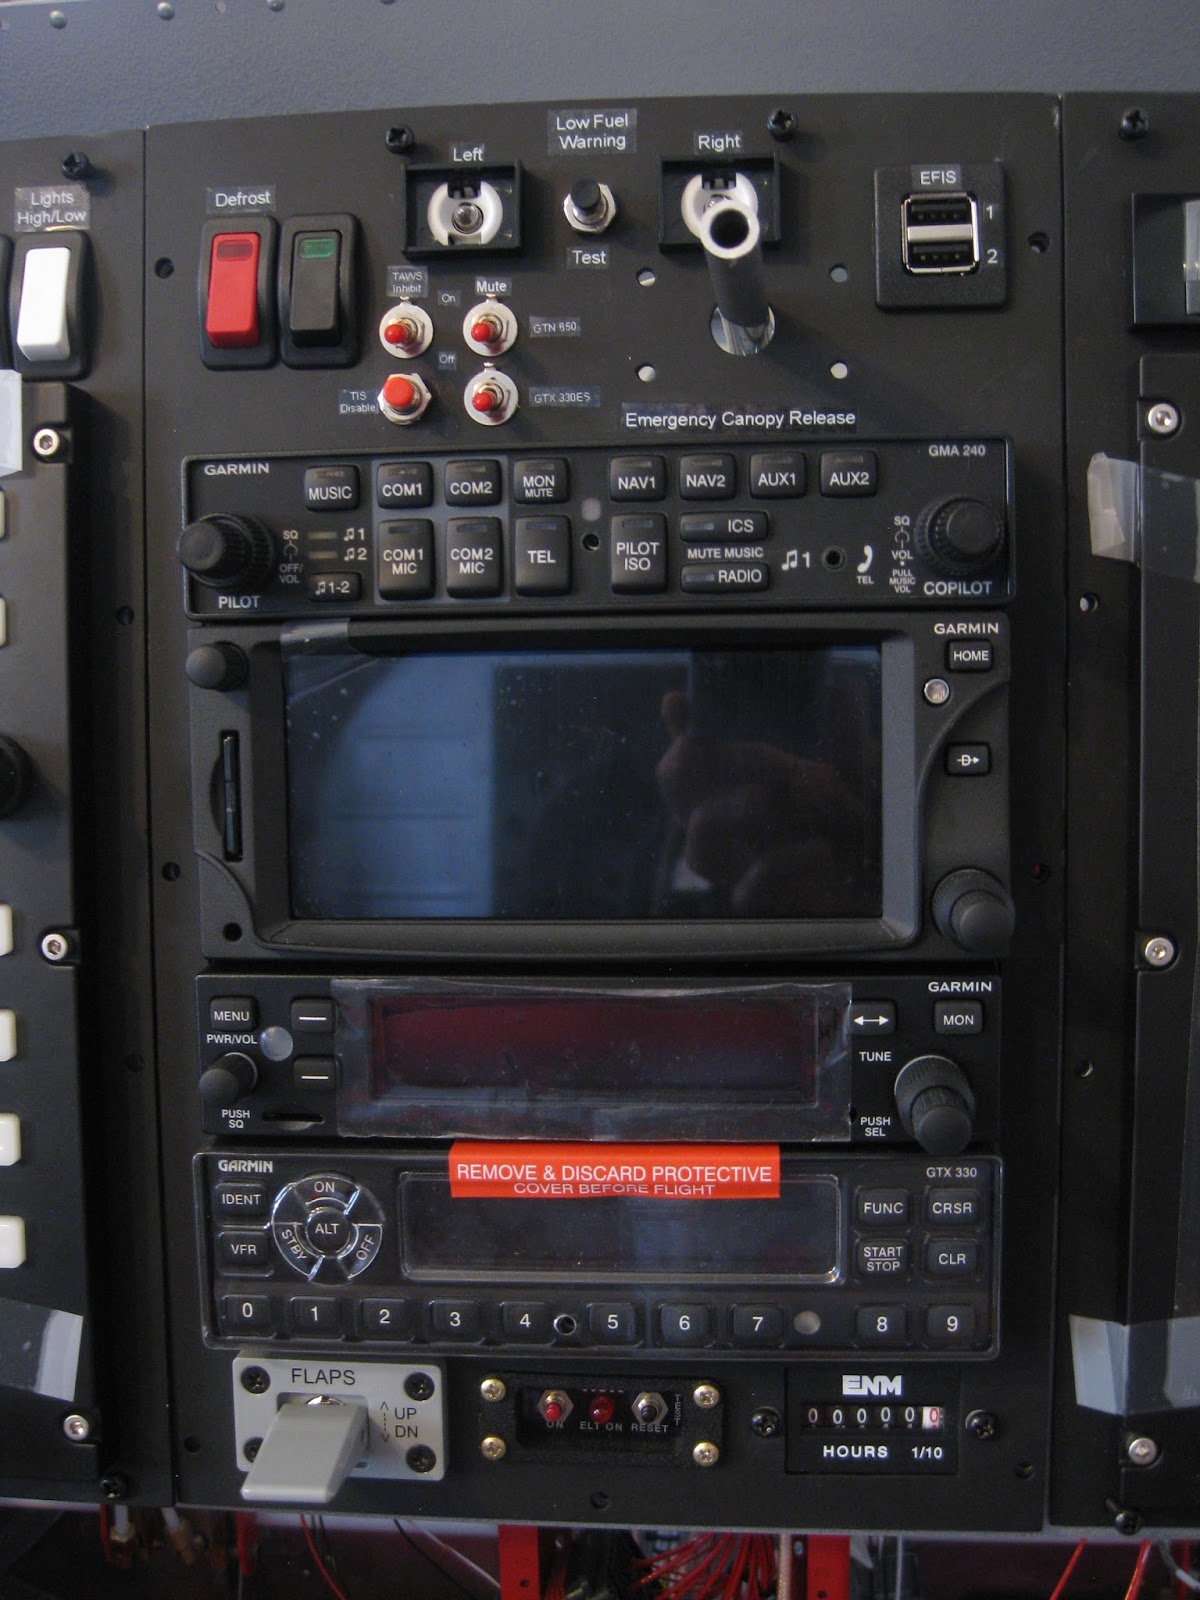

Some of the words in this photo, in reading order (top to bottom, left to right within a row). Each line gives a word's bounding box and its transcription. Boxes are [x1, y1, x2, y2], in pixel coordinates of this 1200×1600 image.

[556, 117, 590, 130] Low
[594, 114, 628, 129] Fuel
[559, 134, 626, 150] Warning
[698, 135, 741, 152] Right
[453, 148, 484, 162] Left
[920, 171, 956, 186] EFIS
[31, 191, 74, 207] Lights
[215, 192, 272, 208] Defrost
[17, 210, 86, 226] High/Low
[986, 206, 993, 219] 1
[572, 250, 606, 264] Test
[987, 250, 998, 264] 2
[392, 272, 423, 281] TAWS
[393, 284, 422, 293] Inhibit
[476, 280, 507, 293] Mute
[442, 294, 456, 302] On
[533, 323, 556, 334] GTN
[559, 322, 577, 332] 650
[440, 354, 456, 364] Off
[350, 391, 367, 400] TIS
[534, 393, 556, 403] GTX
[558, 392, 590, 402] 330ES
[340, 403, 376, 414] Disable
[626, 412, 716, 429] Emergency
[721, 411, 785, 428] Canopy
[790, 410, 856, 426] Release
[928, 445, 960, 457] GMA
[962, 444, 986, 456] 240
[204, 462, 270, 476] GARMIN
[522, 475, 556, 488] MON
[618, 476, 656, 490] NAV1
[686, 474, 726, 488] NAV2
[758, 472, 796, 486] AUX1
[830, 472, 870, 486] AUX2
[308, 486, 352, 500] MUSIC
[382, 483, 423, 497] COM1
[450, 481, 493, 494] COM2
[524, 488, 554, 498] MUTE
[728, 519, 754, 533] ICS
[894, 516, 910, 526] SQ
[283, 530, 299, 540] SQ
[358, 528, 365, 540] 1
[357, 548, 368, 560] 2
[450, 548, 494, 560] COM2
[616, 542, 660, 556] PILOT
[688, 548, 721, 560] MUTE
[724, 546, 764, 558] MUSIC
[891, 550, 914, 560] VOL
[528, 550, 556, 564] TEL
[802, 551, 810, 568] 1
[392, 562, 418, 574] MIC
[459, 562, 485, 574] MIC
[624, 558, 651, 571] ISO
[279, 574, 300, 584] VOL
[718, 569, 762, 584] RADIO
[856, 575, 874, 584] TEL
[892, 568, 912, 578] PULL
[889, 576, 916, 586] MUSIC
[894, 585, 911, 594] VOL
[924, 581, 992, 596] COPILOT
[218, 595, 260, 609] PILOT
[934, 622, 999, 634] GARMIN
[954, 650, 990, 661] HOME
[928, 981, 992, 992] GARMIN
[214, 1010, 250, 1022] MENU
[943, 1014, 974, 1026] MON
[206, 1034, 258, 1044] PWR/VOL
[859, 1051, 892, 1062] TUNE
[222, 1109, 250, 1118] PUSH
[228, 1120, 244, 1129] SQ
[860, 1116, 890, 1126] PUSH
[864, 1127, 886, 1137] SEL
[218, 1159, 274, 1173] GARMIN
[926, 1167, 952, 1178] GTX
[955, 1167, 978, 1178] 330
[457, 1164, 538, 1180] REMOVE
[543, 1166, 556, 1180] &
[562, 1165, 646, 1182] DISCARD
[652, 1166, 772, 1182] PROTECTIVE
[314, 1181, 335, 1193] ON
[514, 1182, 573, 1194] COVER
[578, 1183, 649, 1194] BEFORE
[654, 1184, 715, 1196] FLIGHT
[222, 1194, 261, 1206] IDENT
[864, 1202, 904, 1214] FUNC
[932, 1202, 972, 1214] CRSR
[315, 1223, 339, 1234] ALT
[230, 1244, 257, 1255] VFR
[281, 1229, 308, 1260] STBY
[356, 1234, 376, 1261] OFF
[863, 1246, 904, 1258] START
[938, 1253, 966, 1265] CLR
[866, 1260, 900, 1272] STOP
[242, 1302, 253, 1318] 0
[310, 1306, 318, 1321] 1
[379, 1308, 390, 1324] 2
[450, 1312, 461, 1326] 3
[520, 1314, 530, 1328] 4
[607, 1314, 618, 1329] 5
[679, 1316, 690, 1330] 6
[752, 1316, 764, 1331] 7
[876, 1316, 888, 1332] 8
[946, 1315, 958, 1332] 9
[292, 1368, 356, 1386] FLAPS
[842, 1374, 902, 1396] ENM
[394, 1407, 417, 1420] UP
[674, 1394, 682, 1426] TEST
[394, 1425, 418, 1438] DN
[580, 1421, 600, 1431] ELT
[605, 1422, 623, 1432] ON
[631, 1423, 668, 1434] RESET
[822, 1444, 888, 1458] HOURS
[912, 1446, 943, 1460] 1/10
